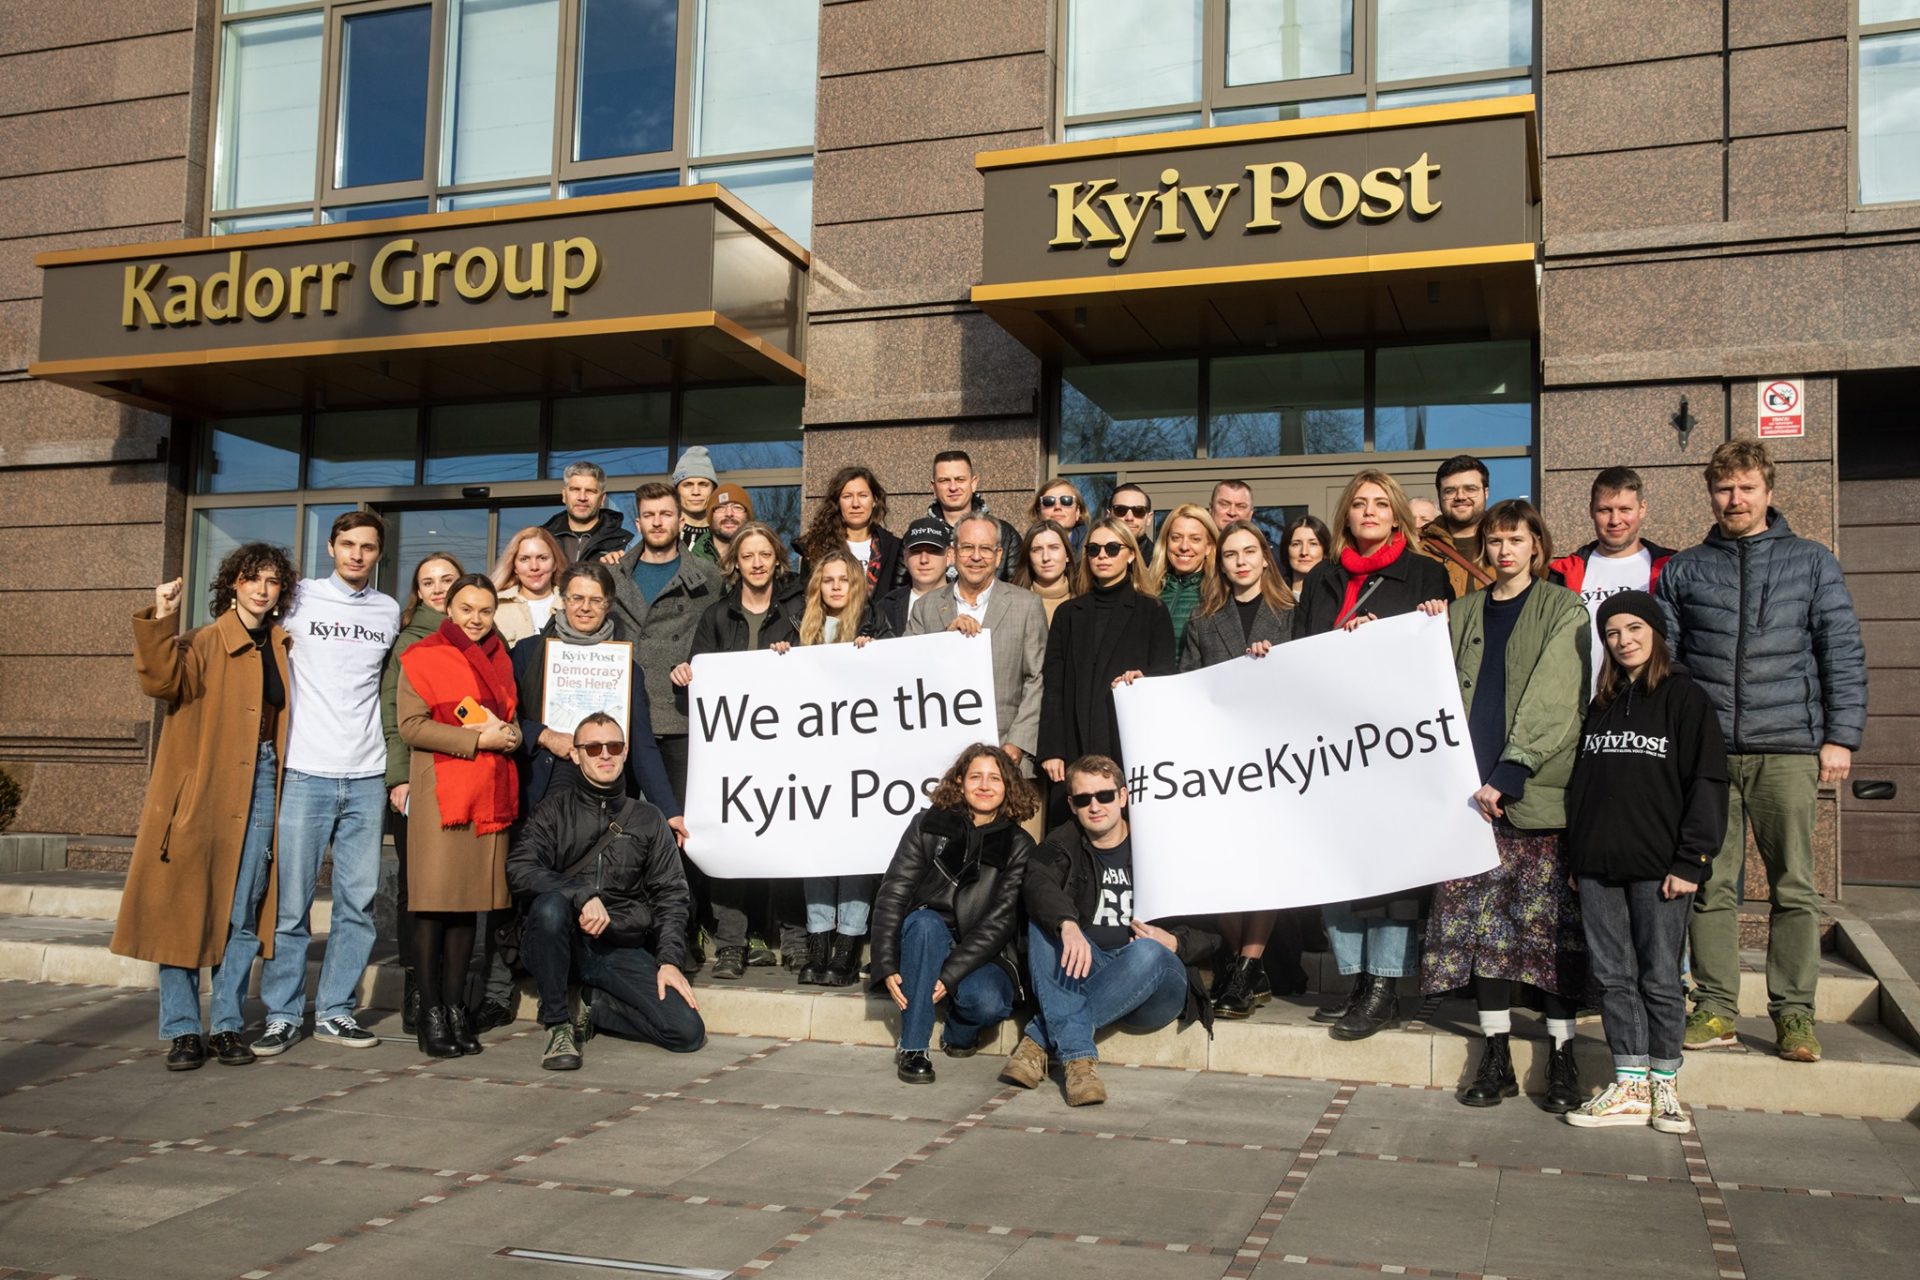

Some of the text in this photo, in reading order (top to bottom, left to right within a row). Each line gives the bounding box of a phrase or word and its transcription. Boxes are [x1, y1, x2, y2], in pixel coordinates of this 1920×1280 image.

[1049, 151, 1443, 262] Kyiv Post
[120, 235, 600, 329] Kadorr Group
[1581, 587, 1614, 605] yiv
[309, 621, 386, 644] Kyiv Post
[552, 663, 624, 679] Democracy
[562, 650, 615, 662] Kyiv Post
[556, 676, 618, 690] Dies Here?
[696, 678, 983, 742] We are the
[1128, 708, 1460, 805] #SaveKyivPost
[721, 769, 941, 837] Kyiv Pos
